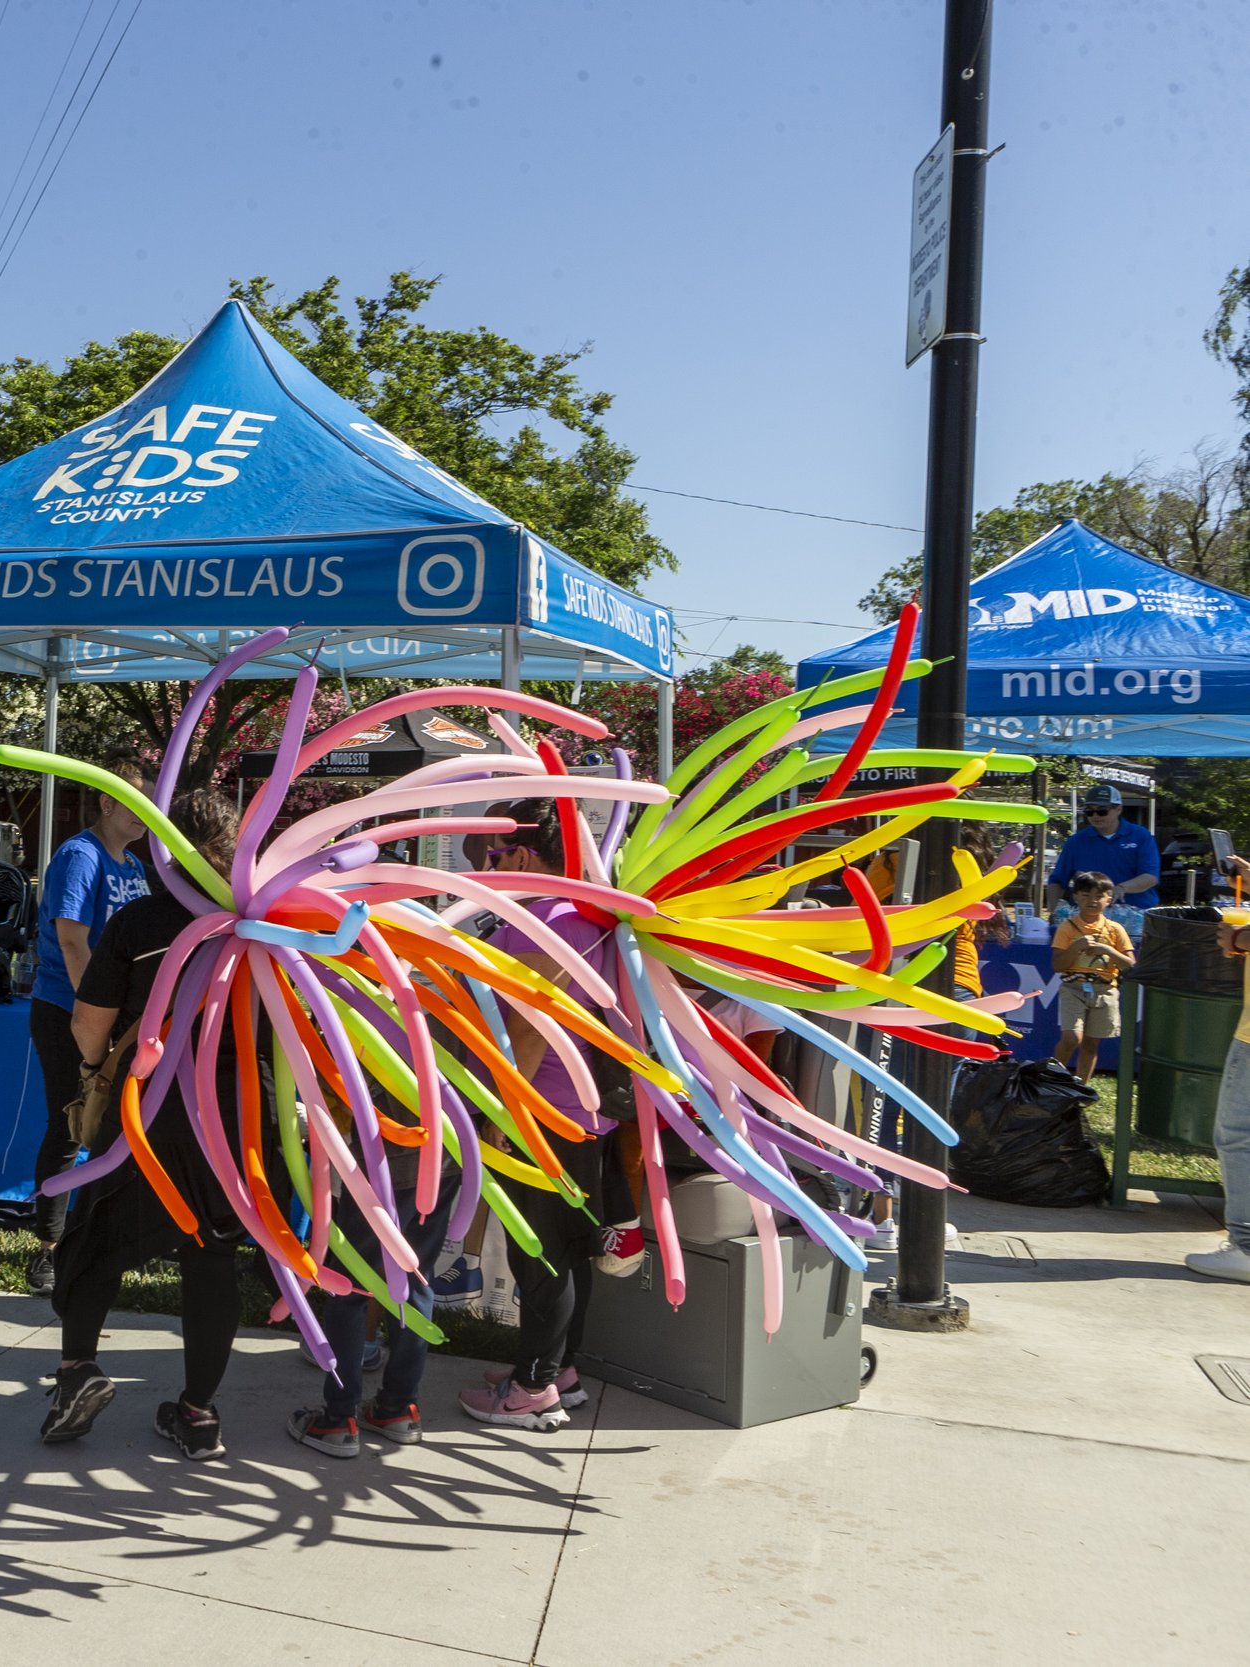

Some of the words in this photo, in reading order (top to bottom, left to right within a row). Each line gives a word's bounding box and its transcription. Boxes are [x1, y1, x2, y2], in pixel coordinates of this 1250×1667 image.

[66, 404, 277, 460] SAFE
[36, 491, 206, 513] STANISLAUS
[50, 507, 171, 525] COUNTY
[69, 556, 344, 598] STANISLAUS
[562, 573, 588, 617] SAFE
[586, 583, 609, 624] KIDS
[1002, 663, 1201, 704] mid.org
[330, 752, 370, 766] MODESTO
